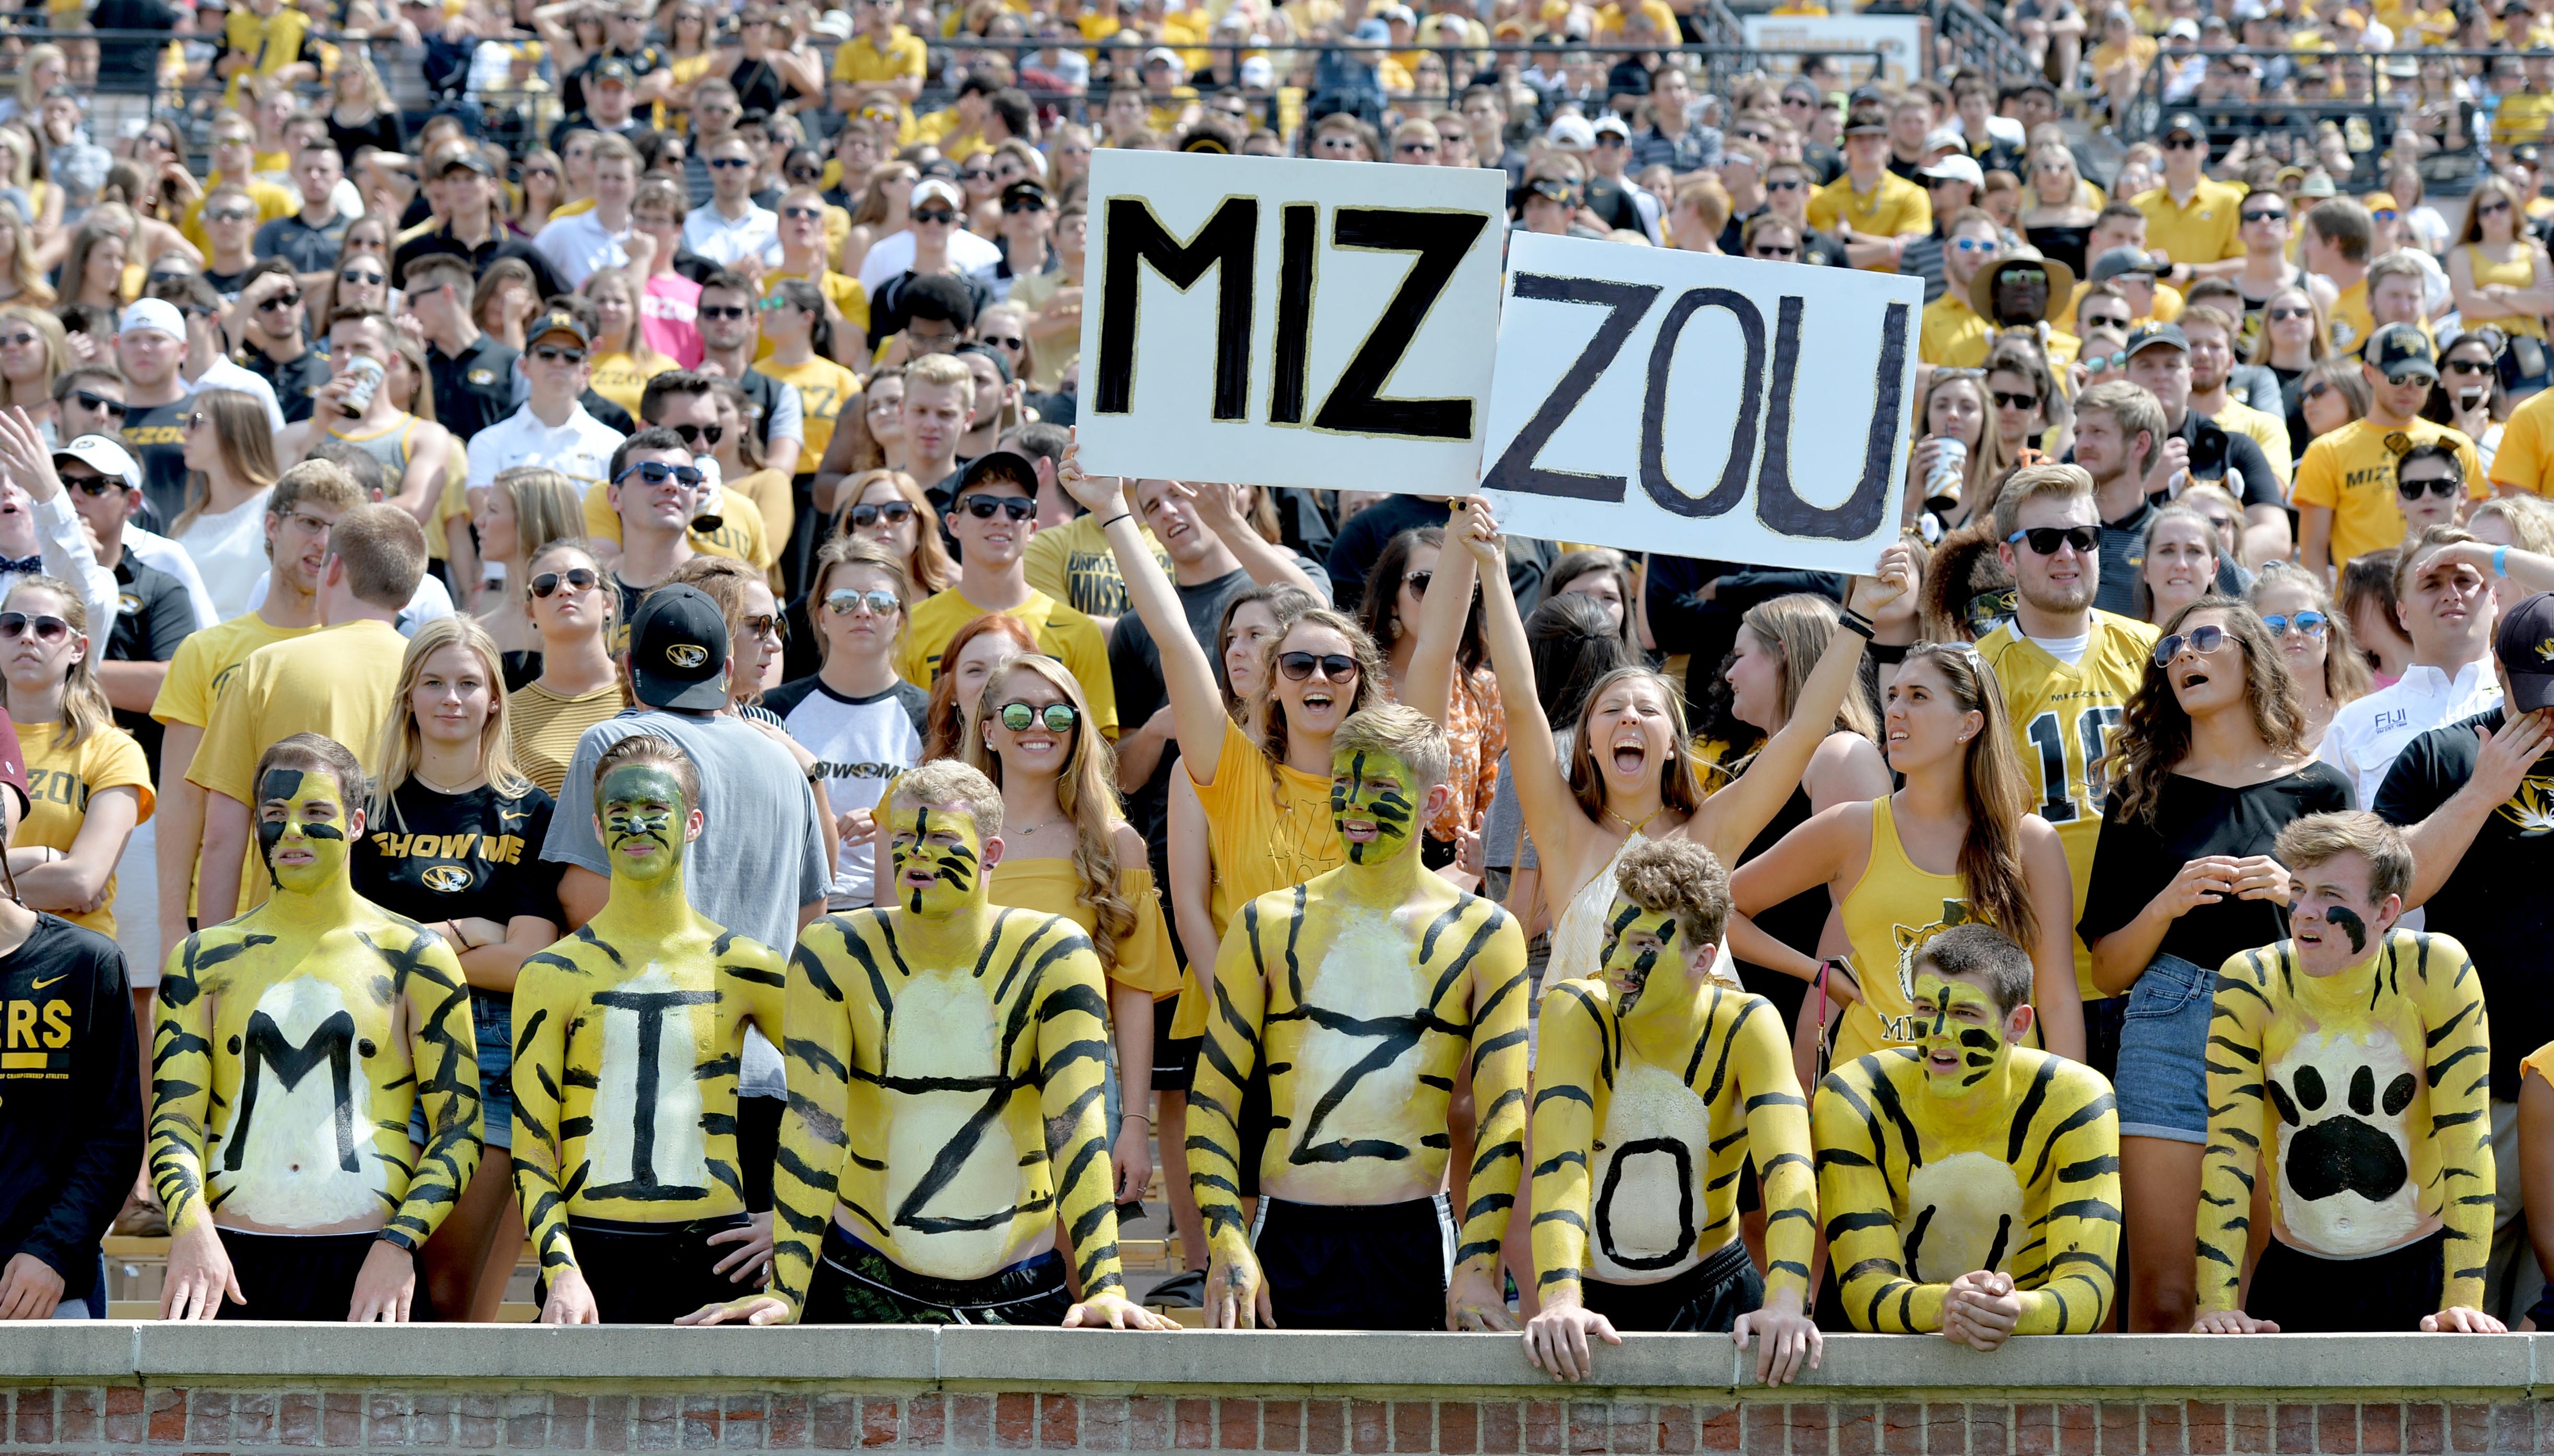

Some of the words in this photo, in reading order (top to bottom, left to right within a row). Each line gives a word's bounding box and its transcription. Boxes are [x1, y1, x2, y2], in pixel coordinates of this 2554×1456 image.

[1092, 194, 1493, 443] MIZ
[1481, 270, 1912, 544] ZOU
[1070, 551, 1120, 571] UNIVE
[2051, 691, 2112, 702] MIZZOU
[2375, 708, 2406, 728] FIJI
[478, 834, 525, 865] ME
[0, 999, 72, 1048] RS
[223, 1010, 361, 1173] M
[583, 989, 723, 1201] I
[1288, 1004, 1435, 1166] Z
[879, 1075, 1018, 1234] Z
[1595, 1137, 1697, 1271] O
